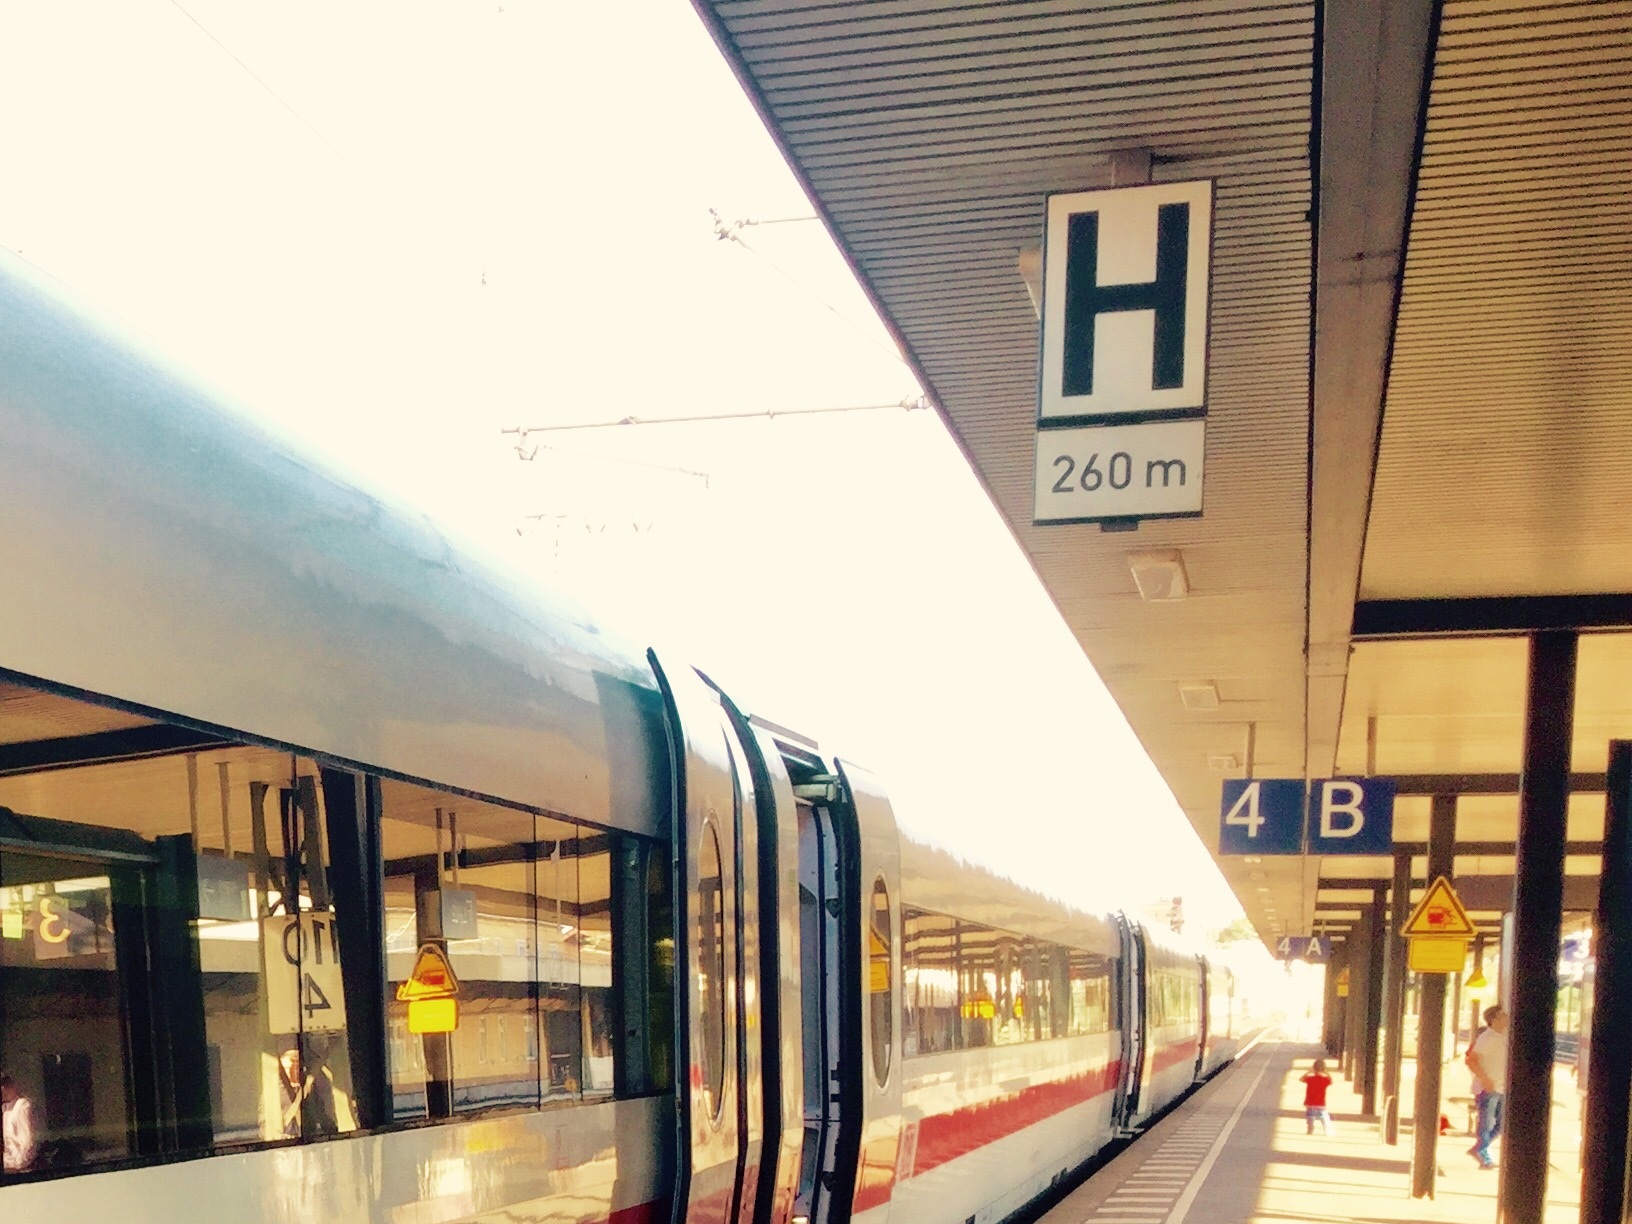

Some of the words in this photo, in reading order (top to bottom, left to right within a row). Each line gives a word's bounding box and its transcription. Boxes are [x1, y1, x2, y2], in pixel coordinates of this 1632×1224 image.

[1062, 201, 1191, 397] H
[1051, 451, 1133, 494] 260
[1145, 458, 1187, 488] m
[1225, 781, 1266, 838] 4
[1319, 781, 1366, 838] B
[1277, 937, 1291, 955] 4
[1306, 937, 1323, 956] A
